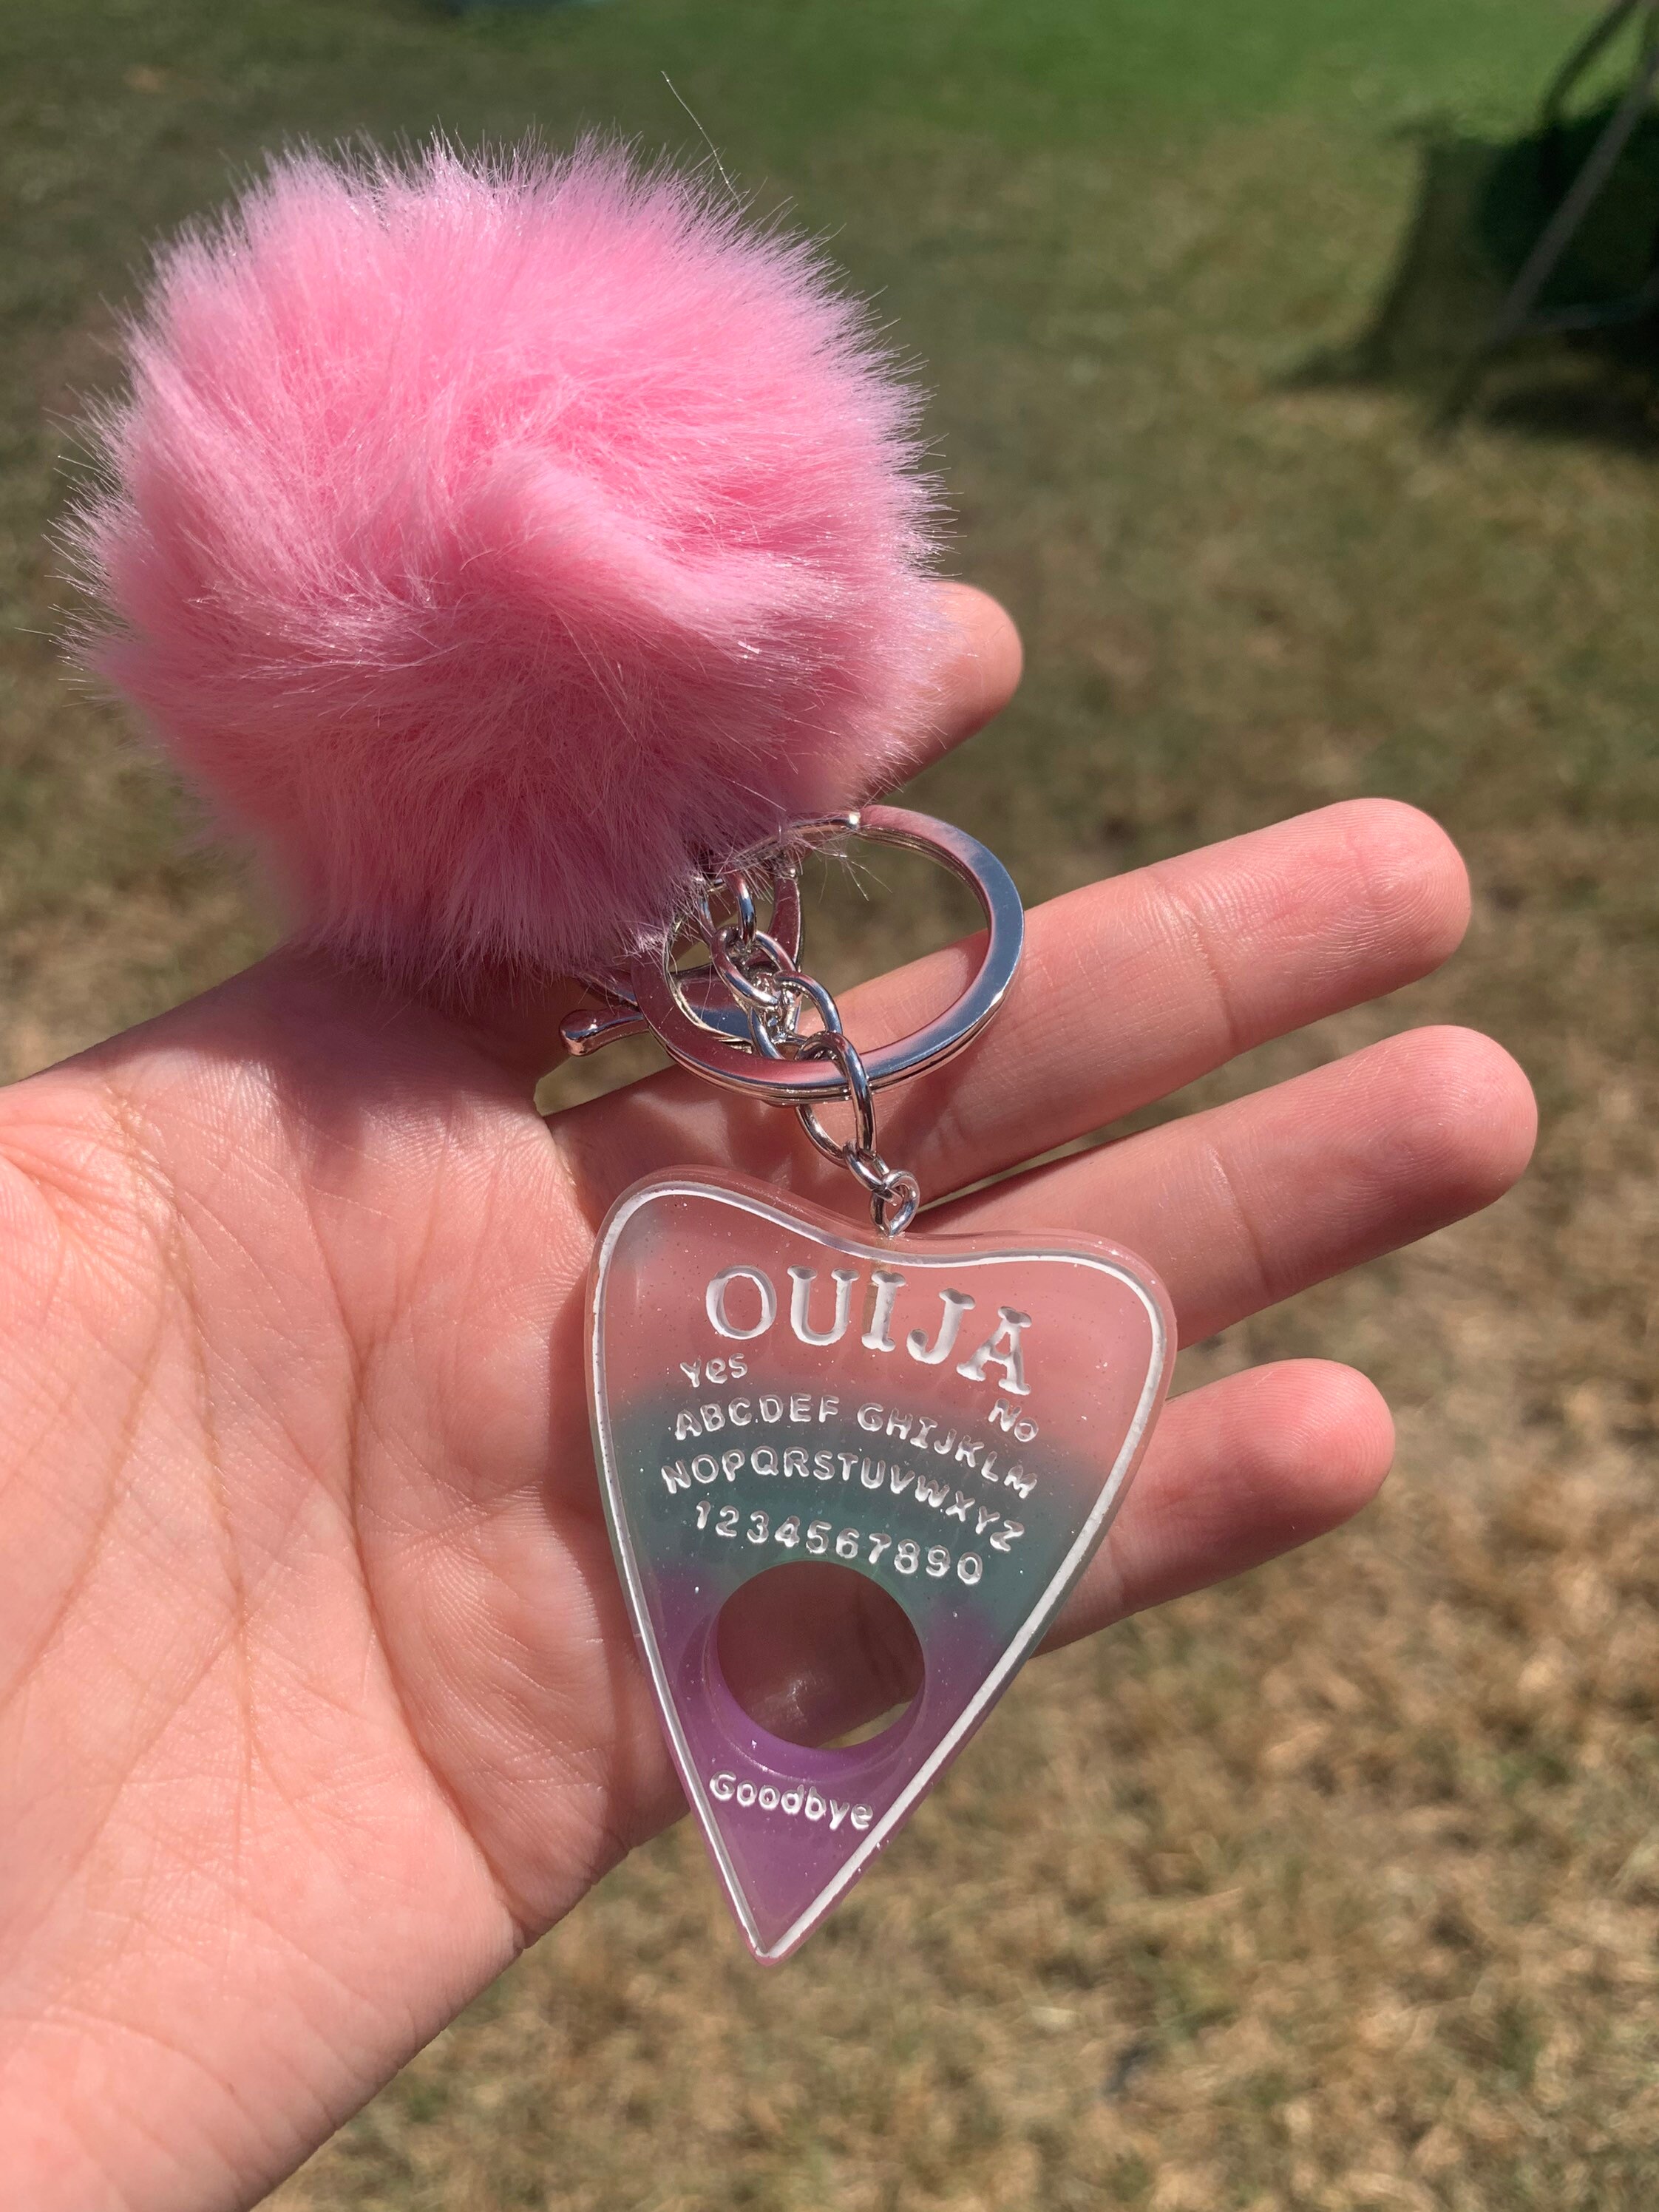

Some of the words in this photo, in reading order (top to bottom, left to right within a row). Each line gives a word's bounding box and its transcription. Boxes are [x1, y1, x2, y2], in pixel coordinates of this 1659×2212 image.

[706, 1265, 1031, 1395] OUIJA
[674, 1394, 839, 1440] ABCDEF
[857, 1402, 1037, 1499] GHIJKLM
[988, 1399, 1038, 1442] No
[662, 1446, 1025, 1551] NOPQRSTUVWXYZ
[696, 1501, 983, 1584] 1234567890
[710, 1771, 873, 1831] Goodbye
